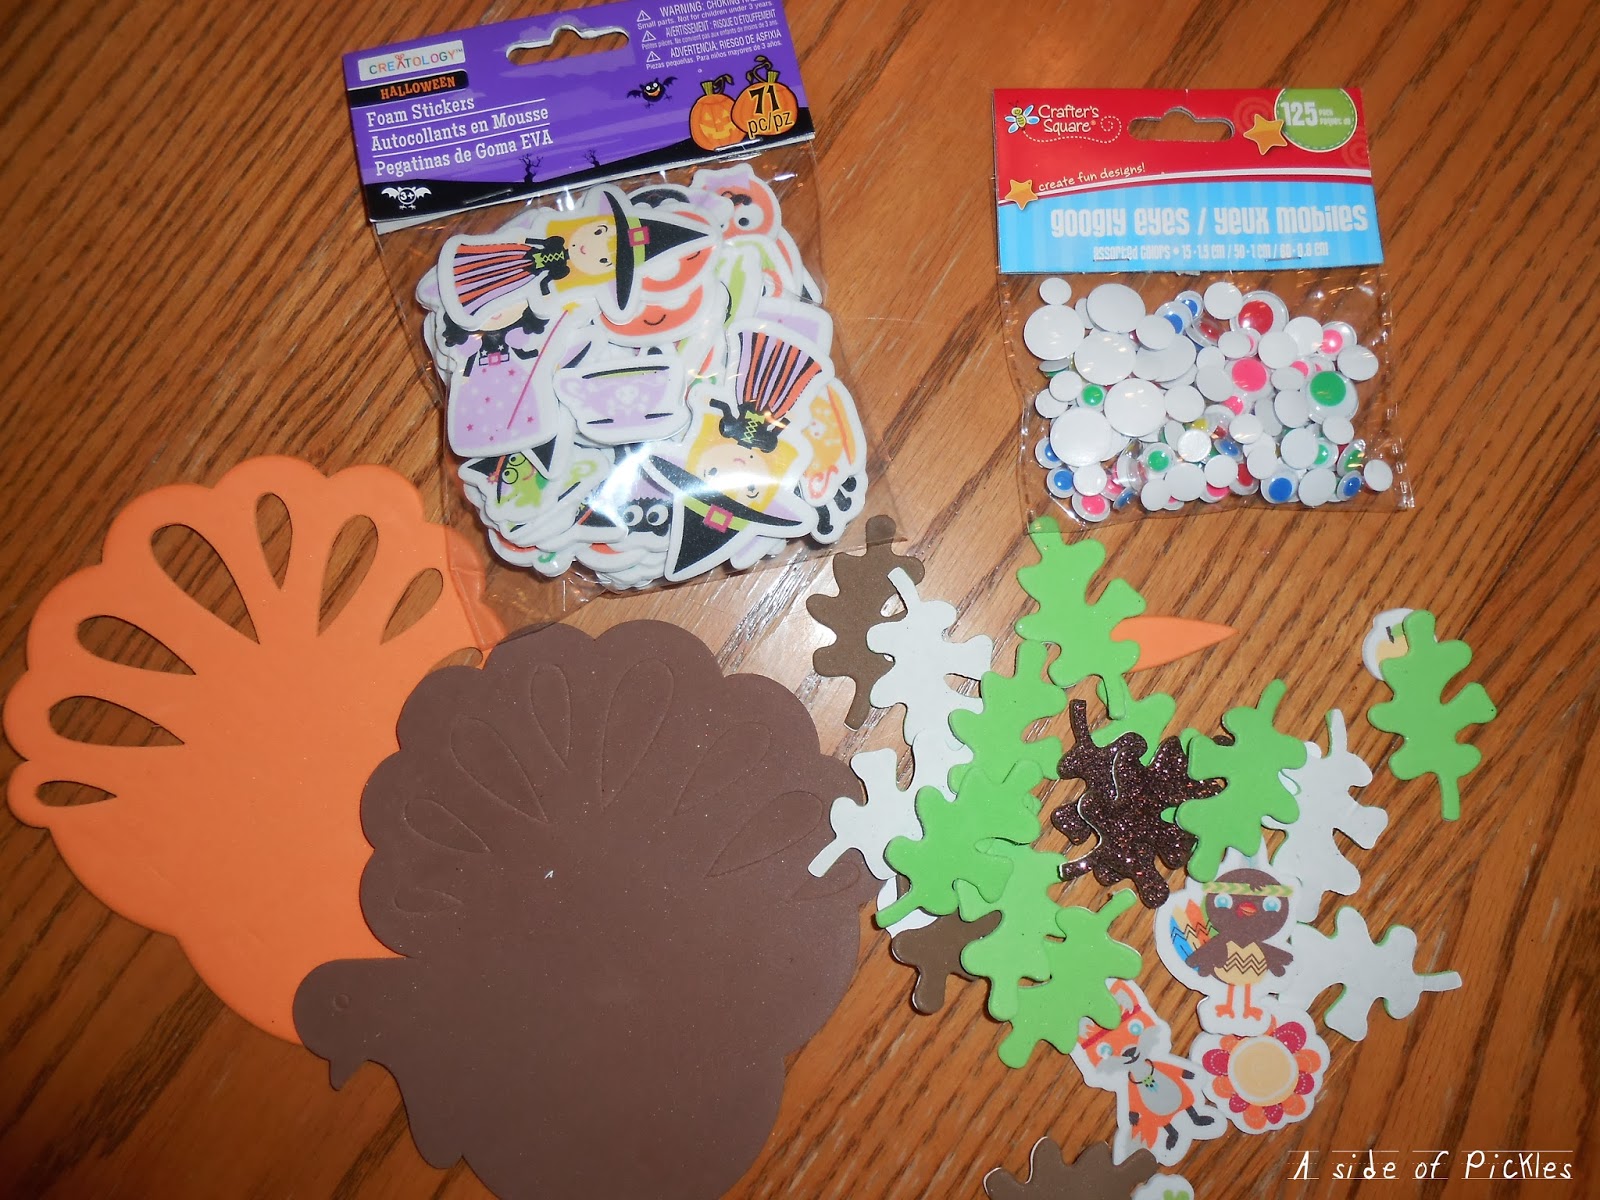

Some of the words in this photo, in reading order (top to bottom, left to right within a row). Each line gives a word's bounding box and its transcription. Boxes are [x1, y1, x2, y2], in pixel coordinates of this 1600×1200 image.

[638, 21, 656, 30] Small
[702, 9, 728, 18] children
[729, 5, 747, 14] under
[660, 2, 705, 17] WARNING:
[713, 17, 734, 28] RISQUE
[670, 40, 718, 58] ADVERTENCIA:
[719, 36, 744, 50] RIESGO
[745, 34, 756, 44] DE
[756, 29, 782, 42] ASFIXIA
[646, 62, 666, 70] Piezas
[728, 46, 752, 56] mayores
[380, 76, 456, 100] HALLOWEEN
[749, 85, 779, 114] 71
[366, 109, 408, 127] Foam
[411, 98, 475, 121] Stickers
[1038, 104, 1099, 118] Crafter's
[1280, 101, 1318, 126] 125
[371, 122, 467, 152] Autocollants
[471, 118, 489, 134] en
[491, 107, 549, 130] Mousse
[748, 112, 792, 138] pc/pz
[375, 152, 450, 178] Pegatinas
[454, 147, 472, 164] de
[475, 140, 517, 160] Goma
[520, 129, 554, 150] EVA
[1039, 175, 1075, 192] create
[1077, 171, 1097, 184] fun
[1100, 161, 1146, 179] designs!
[400, 190, 415, 202] 3+
[1050, 208, 1127, 238] googly
[1134, 207, 1190, 236] eyes
[1214, 206, 1270, 235] yeux
[1276, 204, 1369, 233] mobiles
